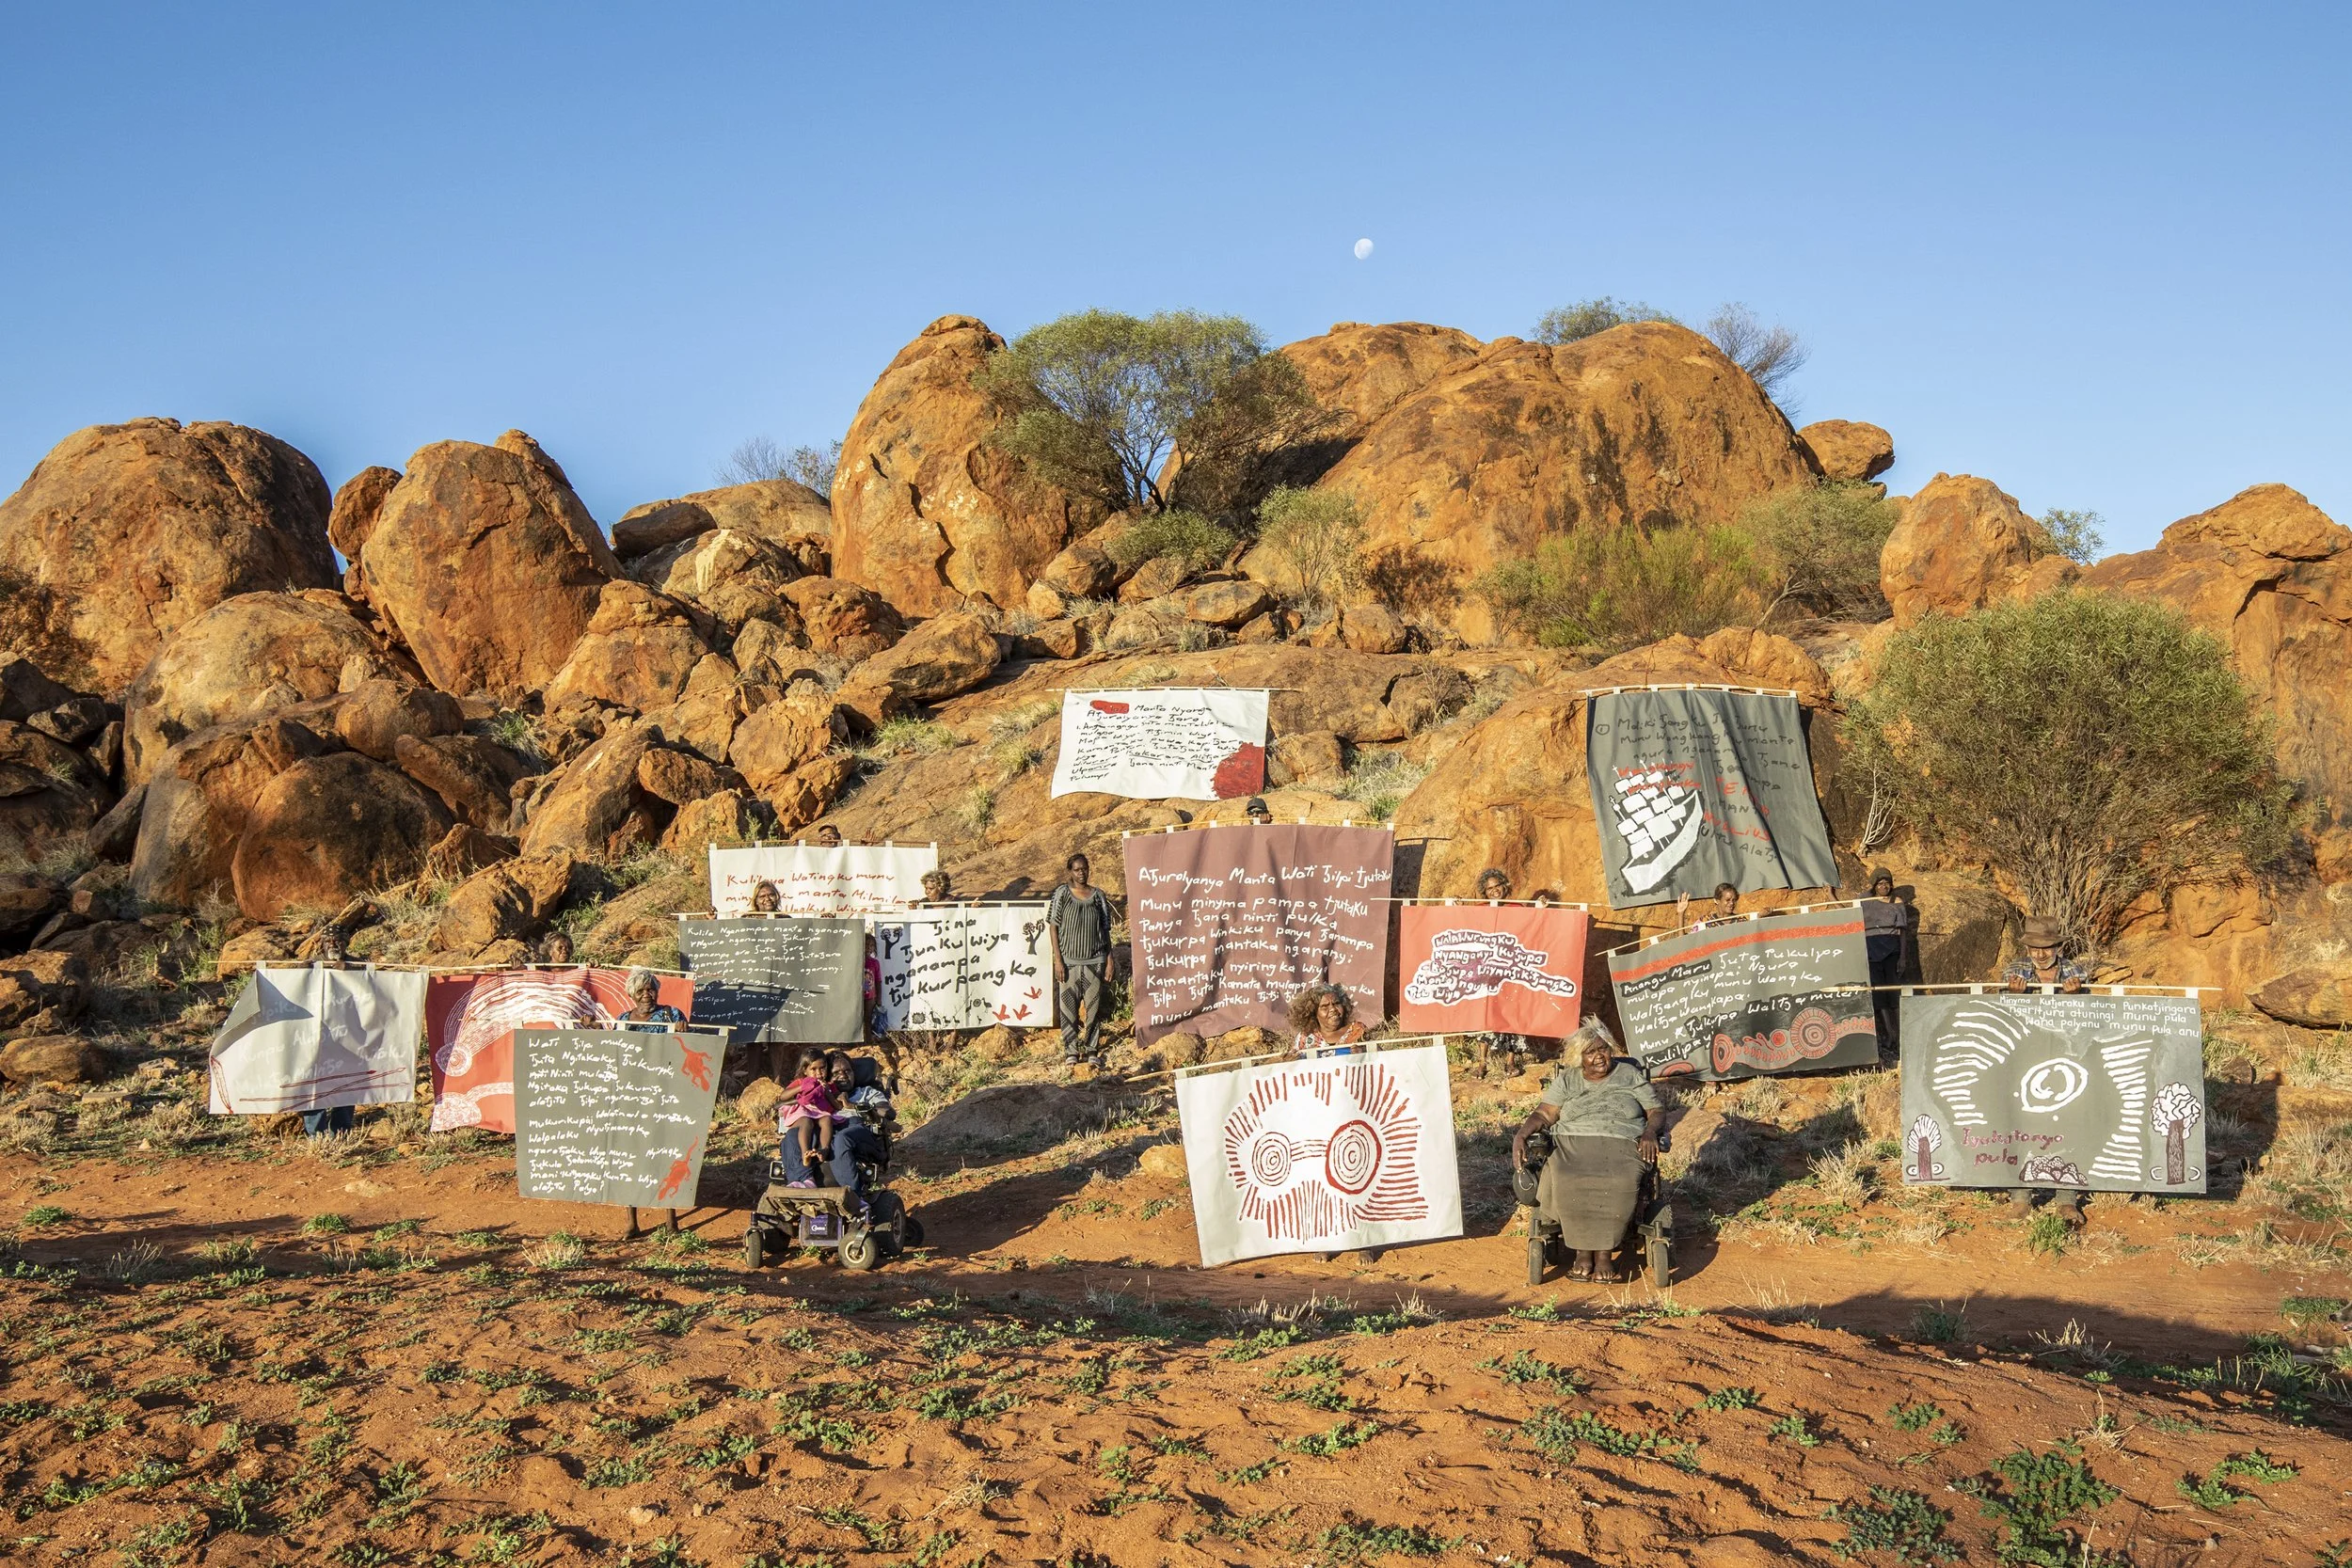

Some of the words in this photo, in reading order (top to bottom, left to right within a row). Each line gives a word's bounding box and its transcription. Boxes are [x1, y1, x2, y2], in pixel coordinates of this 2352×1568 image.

[1191, 896, 1247, 915] minyma
[1252, 897, 1318, 915] pampa
[1275, 927, 1311, 942] panya
[2123, 1012, 2156, 1022] munu
